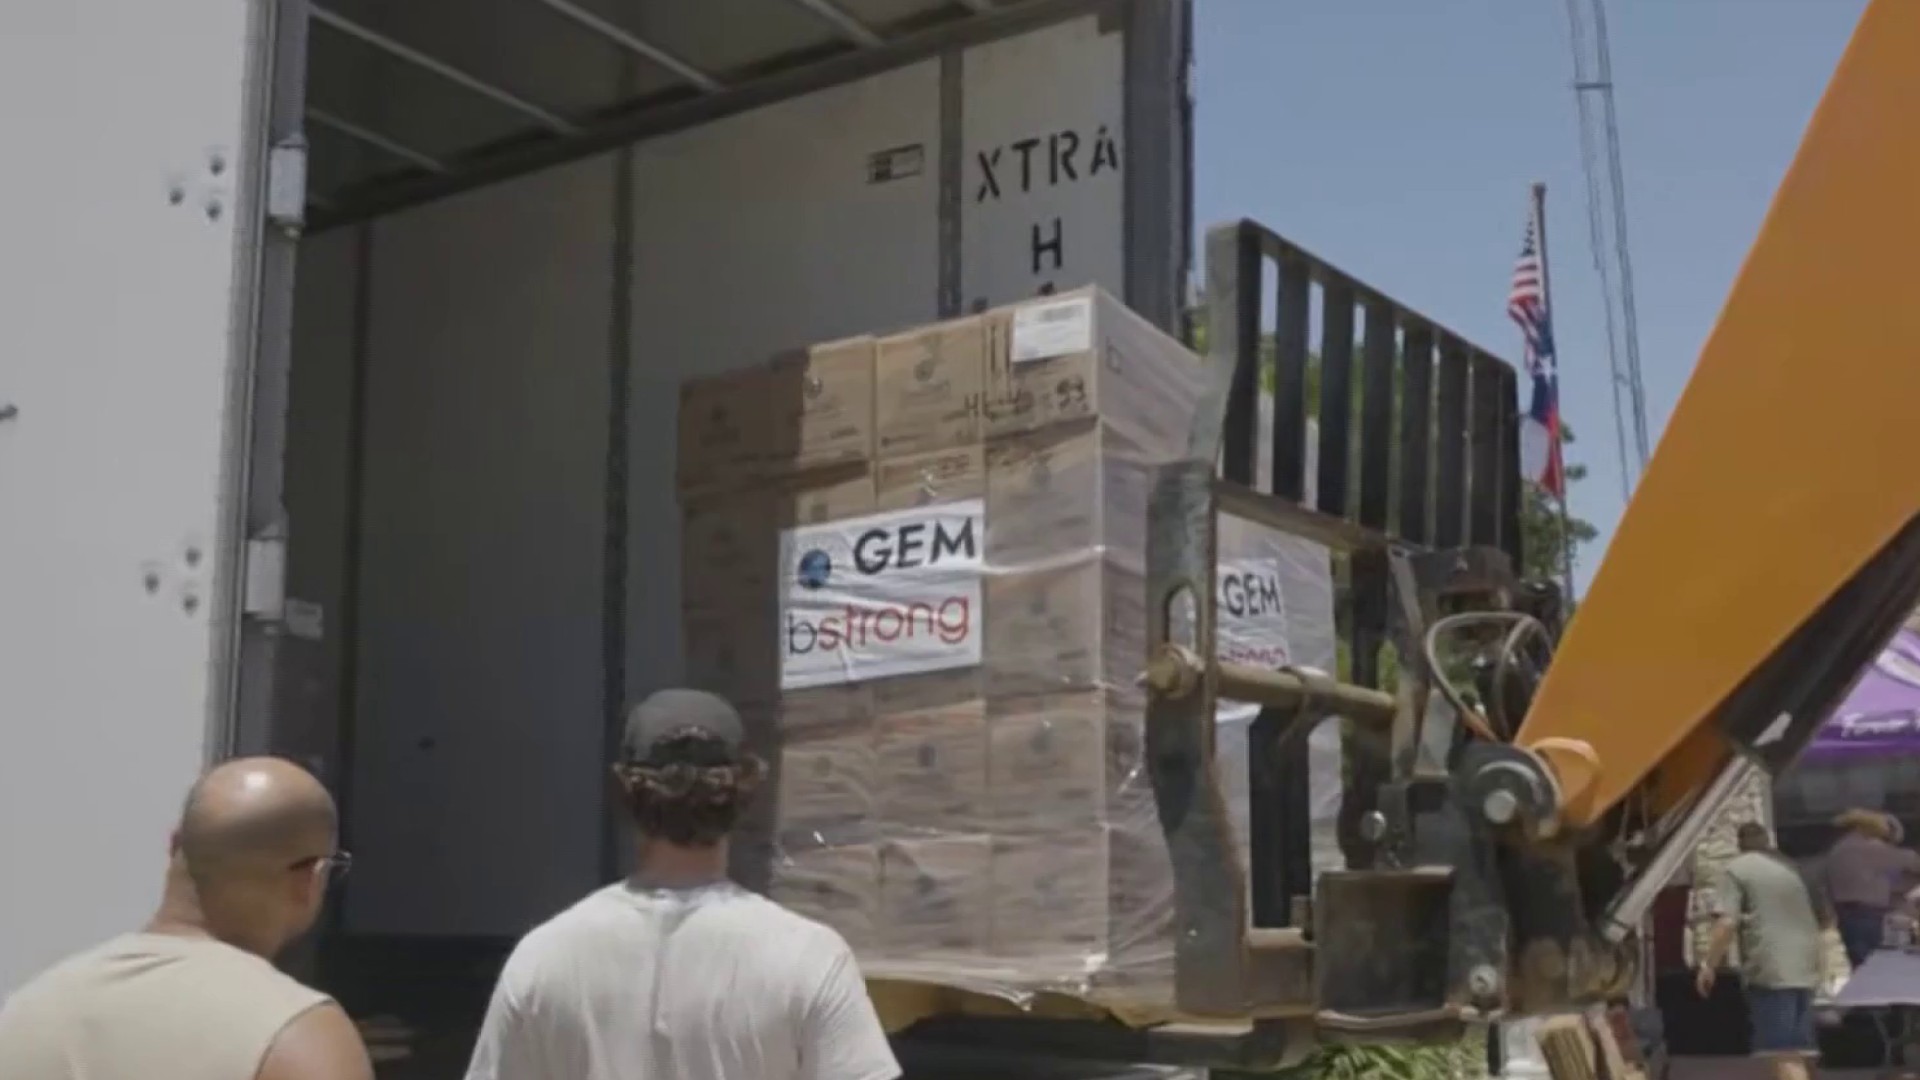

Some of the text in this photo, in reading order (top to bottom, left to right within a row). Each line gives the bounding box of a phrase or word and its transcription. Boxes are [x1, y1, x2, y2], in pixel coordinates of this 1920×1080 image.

[976, 124, 1119, 203] XTRA
[853, 516, 976, 576] GEM
[788, 595, 969, 655] bstrong
[1223, 573, 1281, 617] GEM
